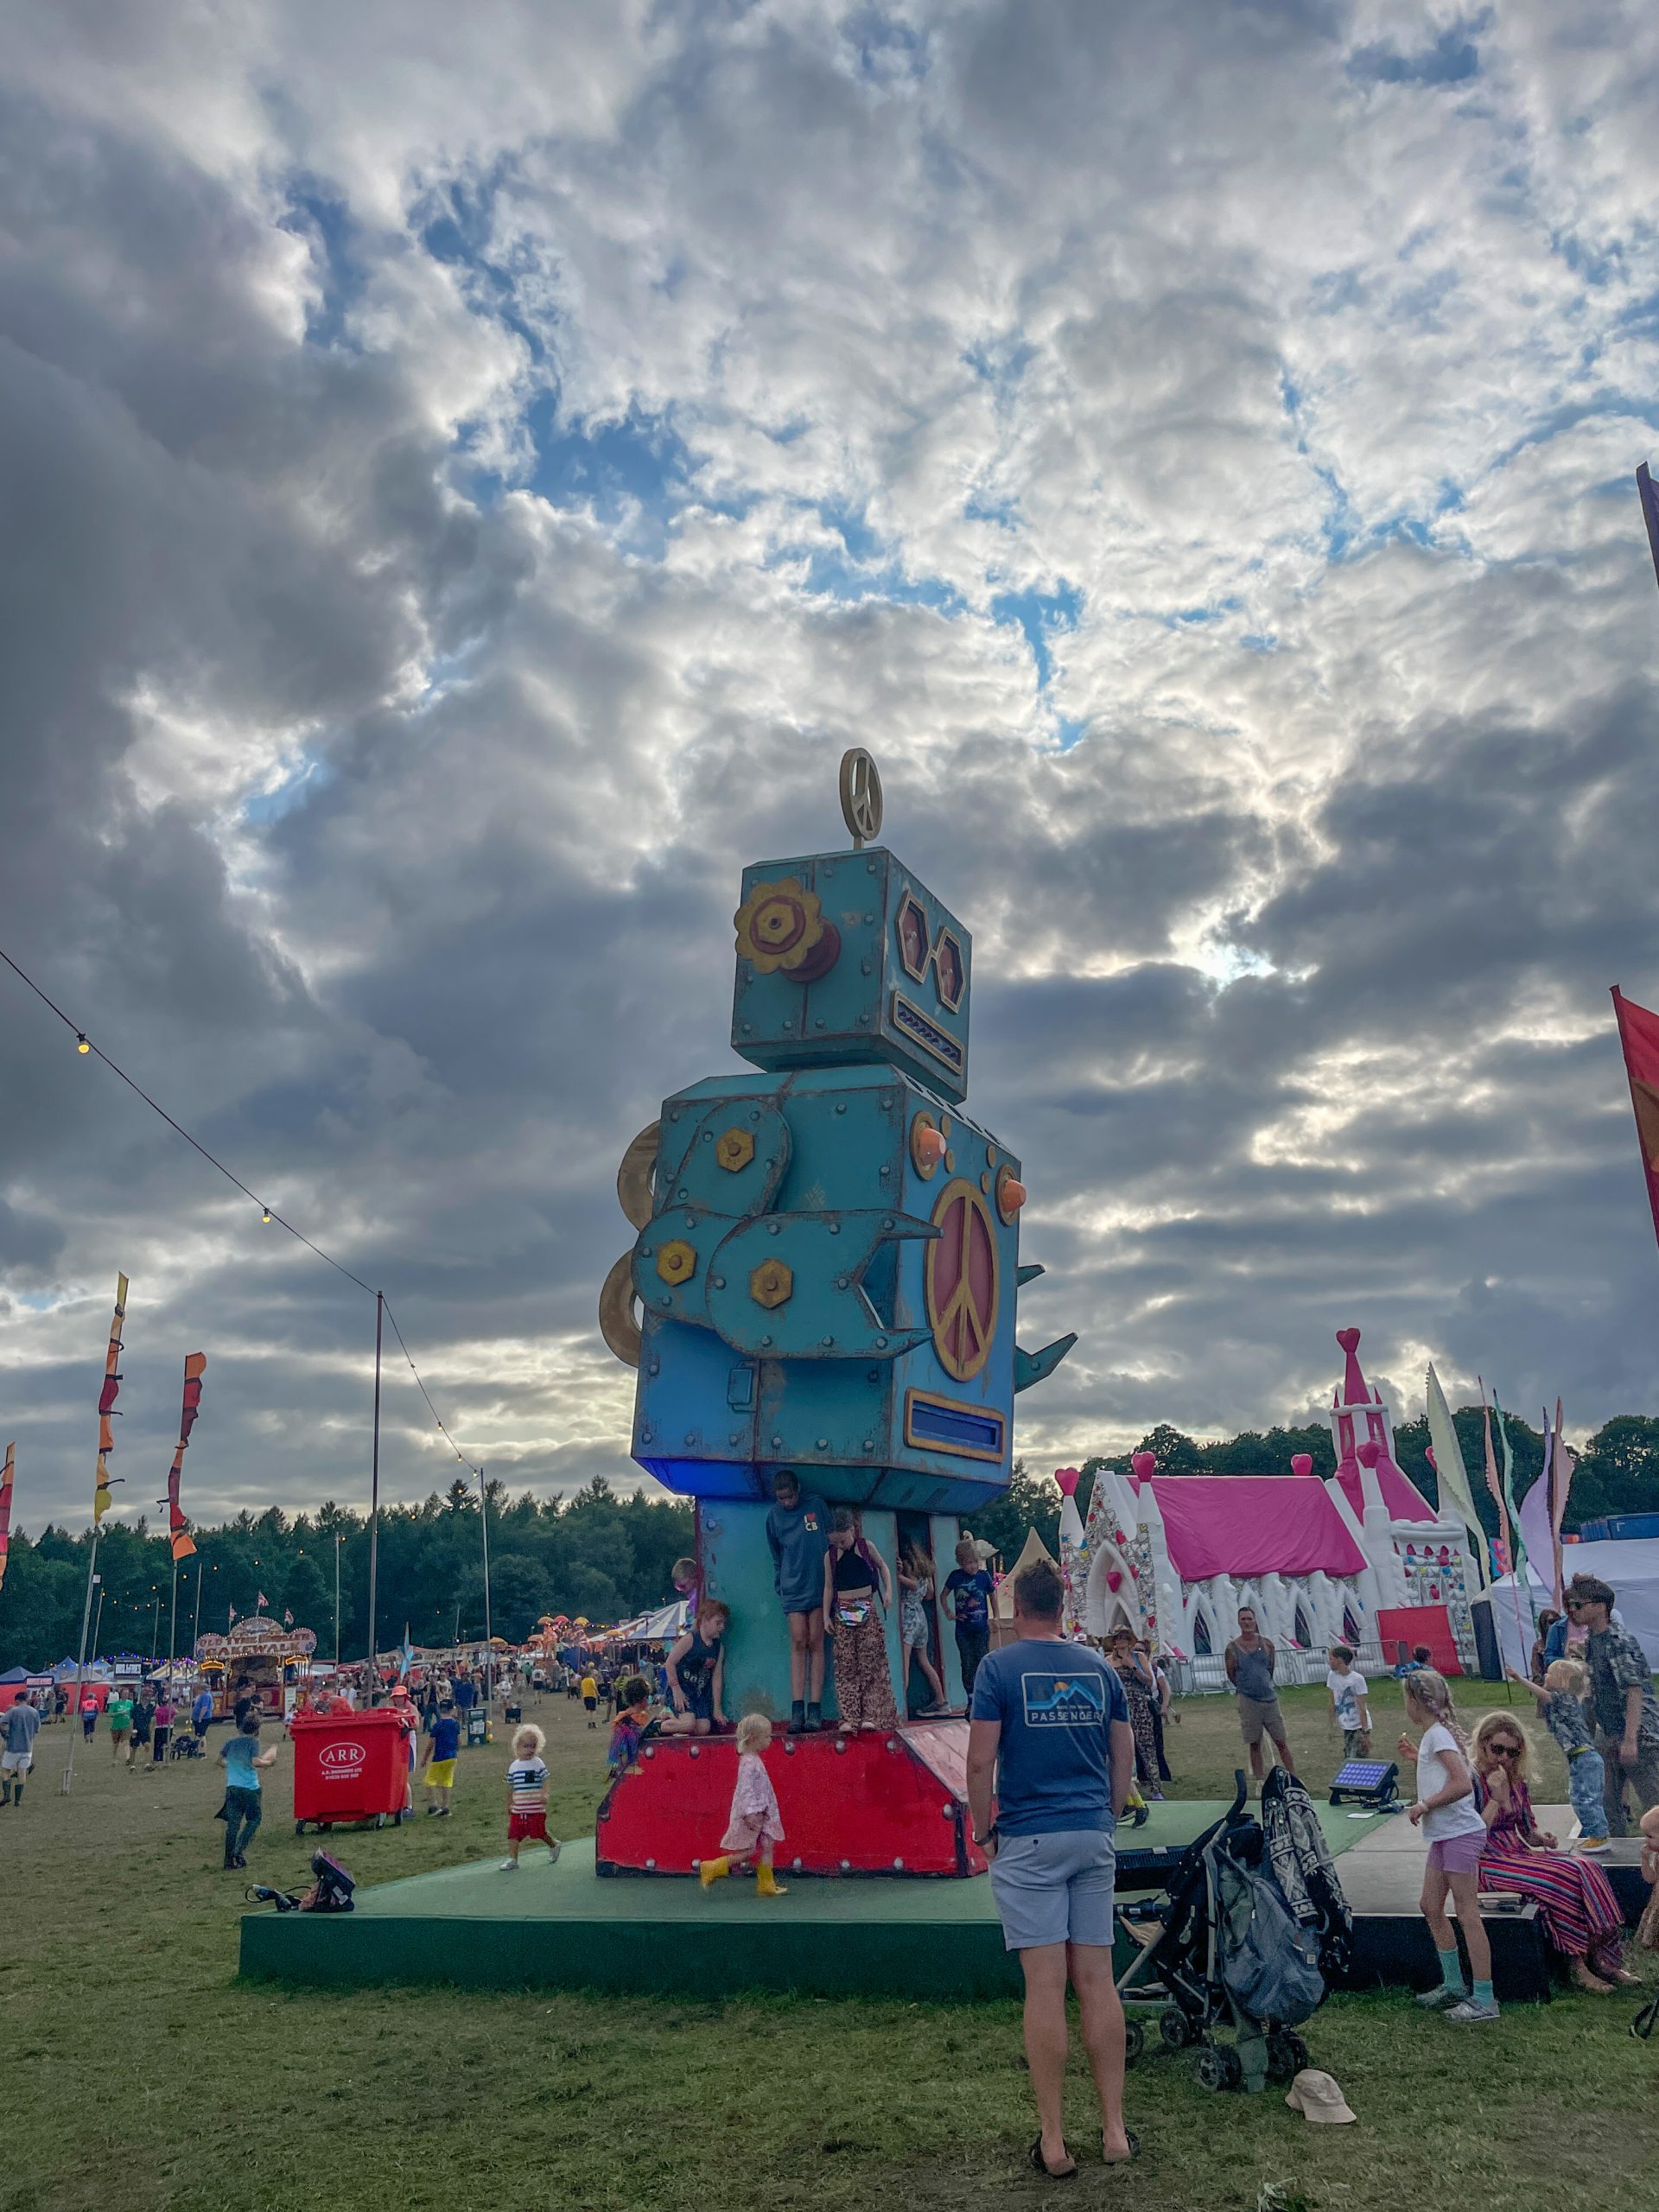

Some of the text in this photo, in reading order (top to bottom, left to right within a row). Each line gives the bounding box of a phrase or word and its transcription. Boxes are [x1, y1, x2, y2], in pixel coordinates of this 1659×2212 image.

[805, 1522, 818, 1531] CB
[206, 1643, 299, 1656] CAKEWALK
[1031, 1711, 1102, 1722] PASSENGER
[325, 1748, 359, 1763] ARR
